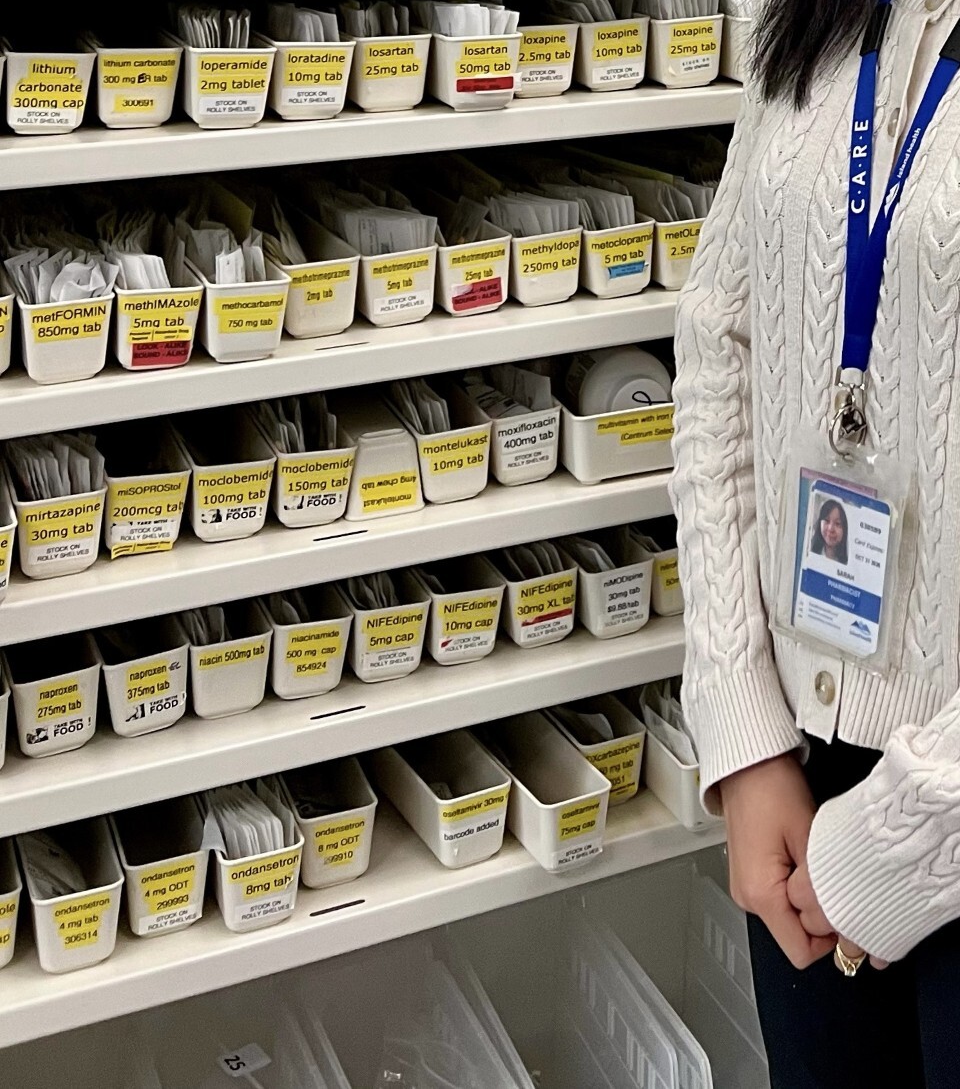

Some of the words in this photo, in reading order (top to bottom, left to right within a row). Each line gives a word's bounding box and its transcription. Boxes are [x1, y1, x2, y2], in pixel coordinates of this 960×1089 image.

[523, 33, 566, 45] loxapine
[597, 27, 639, 41] loxapine
[369, 45, 414, 57] losartan
[464, 44, 508, 55] losartan
[519, 50, 551, 62] 2.5mg
[555, 49, 570, 59] tab
[595, 45, 623, 58] 10mg
[626, 44, 642, 54] tab
[201, 60, 267, 72] loperamide
[288, 53, 345, 64] loratadine
[32, 63, 76, 75] lithium
[366, 64, 397, 76] 25mg
[401, 63, 419, 73] tab
[459, 63, 490, 74] 50mg
[493, 61, 511, 72] tab
[288, 70, 321, 82] 10mg
[325, 70, 343, 81] tab
[18, 82, 82, 92] carbonate
[200, 79, 227, 91] 2mg
[231, 78, 265, 90] tablet
[14, 98, 58, 108] 300mg
[62, 98, 84, 108] cap
[604, 255, 610, 263] 5
[612, 254, 627, 263] mg
[629, 249, 644, 259] tab
[523, 261, 558, 274] 250mg
[562, 257, 577, 267] tab
[124, 298, 199, 311] methIMAzole
[222, 298, 284, 310] methocarbamol
[32, 305, 106, 324] metFORMIN
[133, 317, 160, 328] 5mg
[164, 316, 184, 327] tab
[38, 323, 79, 338] 850mg
[83, 322, 102, 332] tab
[497, 417, 557, 438] moxifloxacin
[423, 435, 488, 455] montelukast
[503, 436, 537, 450] 400mg
[539, 429, 554, 441] tab
[432, 459, 464, 472] 10mg
[467, 453, 484, 464] tab
[117, 483, 181, 497] miSOPROStol
[288, 482, 327, 492] 150mg
[331, 476, 348, 487] tab
[203, 493, 243, 505] 100mg
[248, 489, 266, 500] tab
[25, 502, 101, 523] mirtazapine
[113, 505, 162, 518] 200mcg
[31, 527, 68, 541] 30mg
[73, 523, 93, 534] tab
[521, 579, 573, 598] NIFEdipine
[444, 598, 498, 614] NIFEdipine
[366, 613, 423, 630] NIFEdipine
[445, 619, 472, 632] 10mg
[474, 617, 493, 630] cap
[369, 634, 393, 647] 5mg
[395, 631, 414, 643] cap
[199, 655, 223, 667] niacin
[224, 649, 251, 661] 500mg
[253, 645, 265, 656] tab
[129, 664, 167, 682] naproxen
[39, 683, 78, 700] naproxen
[127, 685, 156, 700] 375mg
[156, 680, 170, 691] tab
[37, 703, 66, 718] 275mg
[68, 699, 82, 710] tab
[53, 722, 84, 737] FOOD
[315, 820, 365, 838] ondansetron
[141, 864, 195, 884] ondansetron
[231, 854, 299, 881] ondansetron
[54, 897, 110, 917] ondansetron
